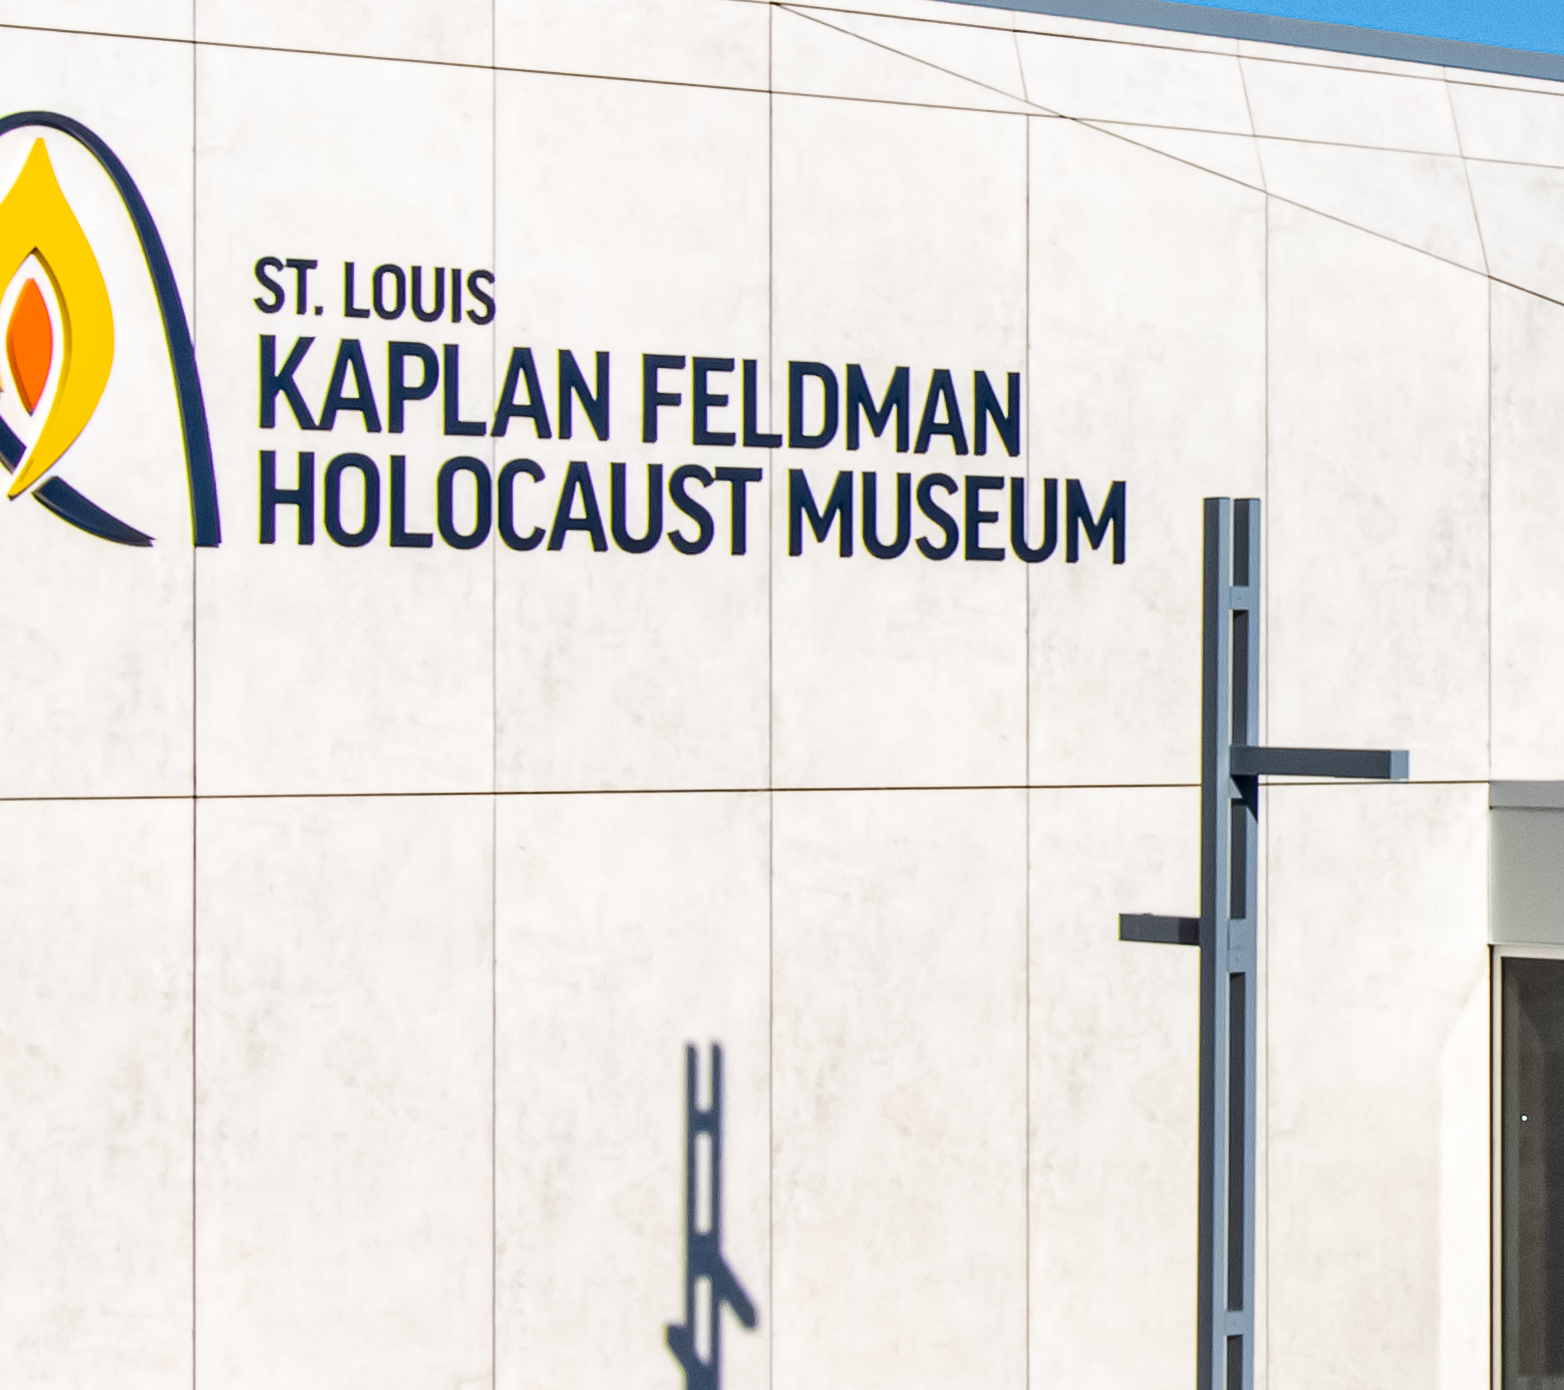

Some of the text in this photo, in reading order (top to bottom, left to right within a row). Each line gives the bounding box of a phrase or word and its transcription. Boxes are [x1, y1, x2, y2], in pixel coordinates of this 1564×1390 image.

[253, 256, 496, 327] ST. LOUIS
[259, 334, 1021, 458] KAPLAN FELDMAN
[259, 449, 1127, 566] HOLOCAUST MUSEUM
